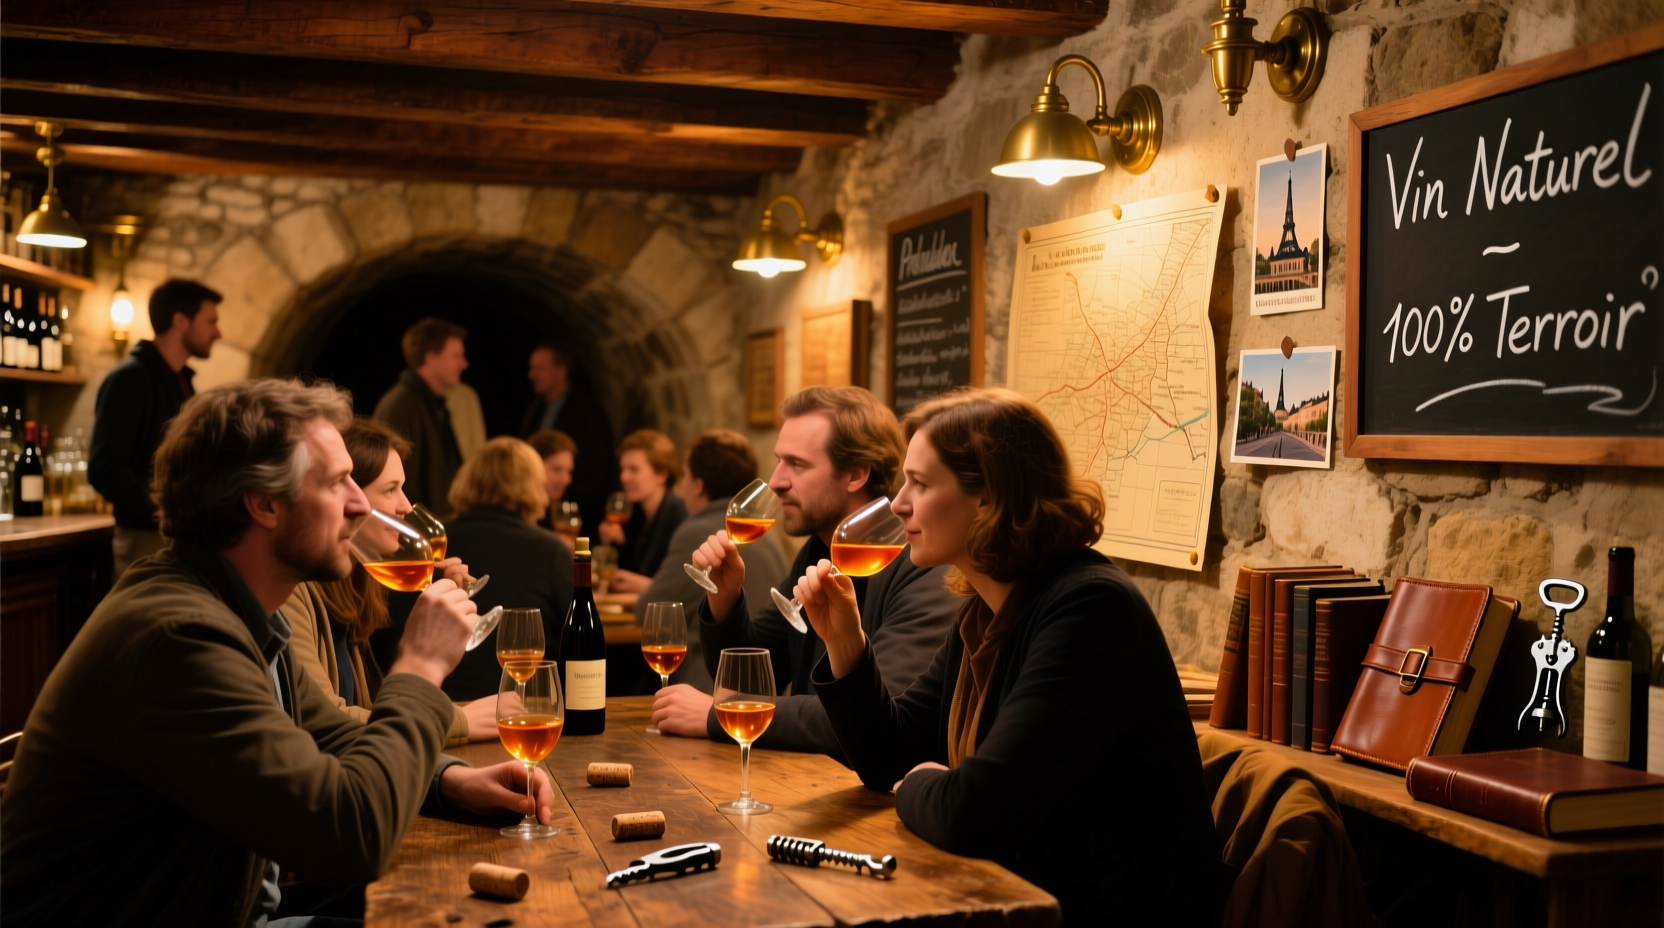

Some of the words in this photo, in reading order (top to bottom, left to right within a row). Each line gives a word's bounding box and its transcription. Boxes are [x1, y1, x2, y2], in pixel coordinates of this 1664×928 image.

[1385, 136, 1449, 230] Vin
[1465, 82, 1652, 217] Naturel
[1382, 292, 1475, 364] 100%
[1485, 284, 1646, 359] Terroir
